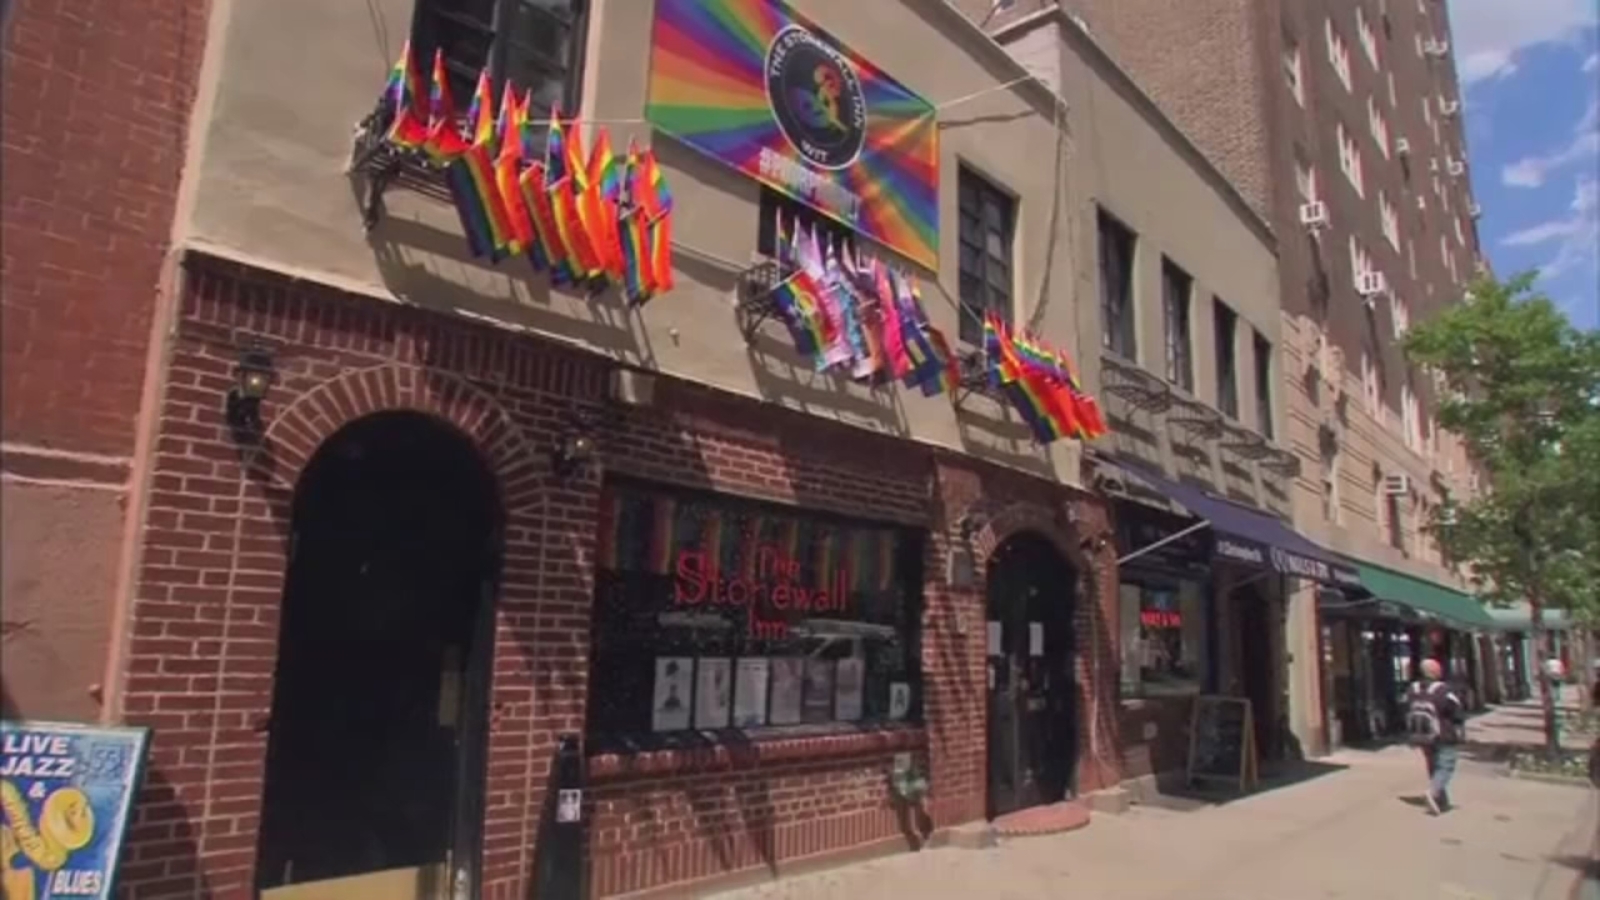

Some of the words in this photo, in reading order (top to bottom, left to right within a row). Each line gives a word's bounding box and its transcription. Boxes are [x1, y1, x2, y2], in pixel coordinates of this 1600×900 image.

[770, 42, 787, 77] THE
[851, 95, 863, 129] INN
[756, 544, 801, 579] The
[674, 549, 847, 611] Stonewall
[748, 609, 788, 640] Inn
[4, 734, 70, 755] LIVE
[0, 757, 75, 776] JAZZ
[28, 781, 46, 798] &
[52, 870, 103, 894] BLUES
